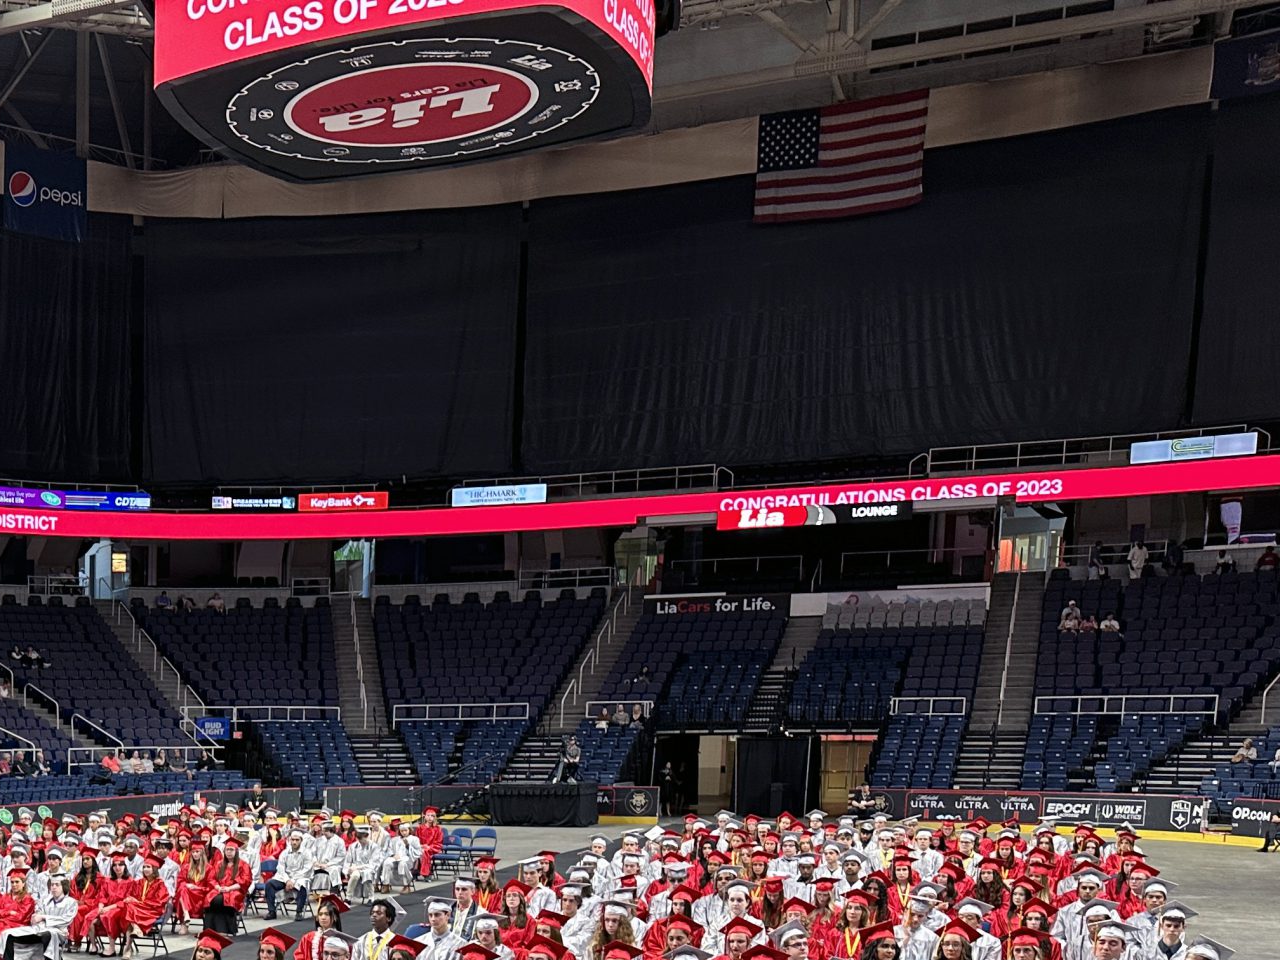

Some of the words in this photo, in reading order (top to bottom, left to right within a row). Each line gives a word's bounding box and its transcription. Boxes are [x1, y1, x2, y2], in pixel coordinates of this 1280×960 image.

[224, 2, 323, 50] CLASS
[333, 0, 377, 24] OF
[604, 0, 638, 49] CLASS
[455, 78, 488, 87] Lia
[400, 86, 449, 98] Cars
[366, 96, 397, 105] for
[319, 84, 501, 132] Lia
[40, 187, 82, 206] pepsi
[720, 488, 906, 511] CONGRATULATIONS
[911, 484, 977, 502] CLASS
[983, 481, 1011, 497] OF
[1015, 479, 1063, 497] 2023
[311, 497, 352, 507] KeyBank
[738, 509, 784, 528] Lia
[852, 505, 898, 518] LOUNGE
[657, 601, 710, 614] LiaCars
[715, 598, 738, 612] for
[743, 598, 776, 611] Life.
[910, 800, 945, 809] ULTRA
[954, 801, 990, 809] ULTRA
[1000, 802, 1036, 810] ULTRA
[1046, 803, 1091, 815] EPOCH
[1115, 805, 1143, 814] WOLF
